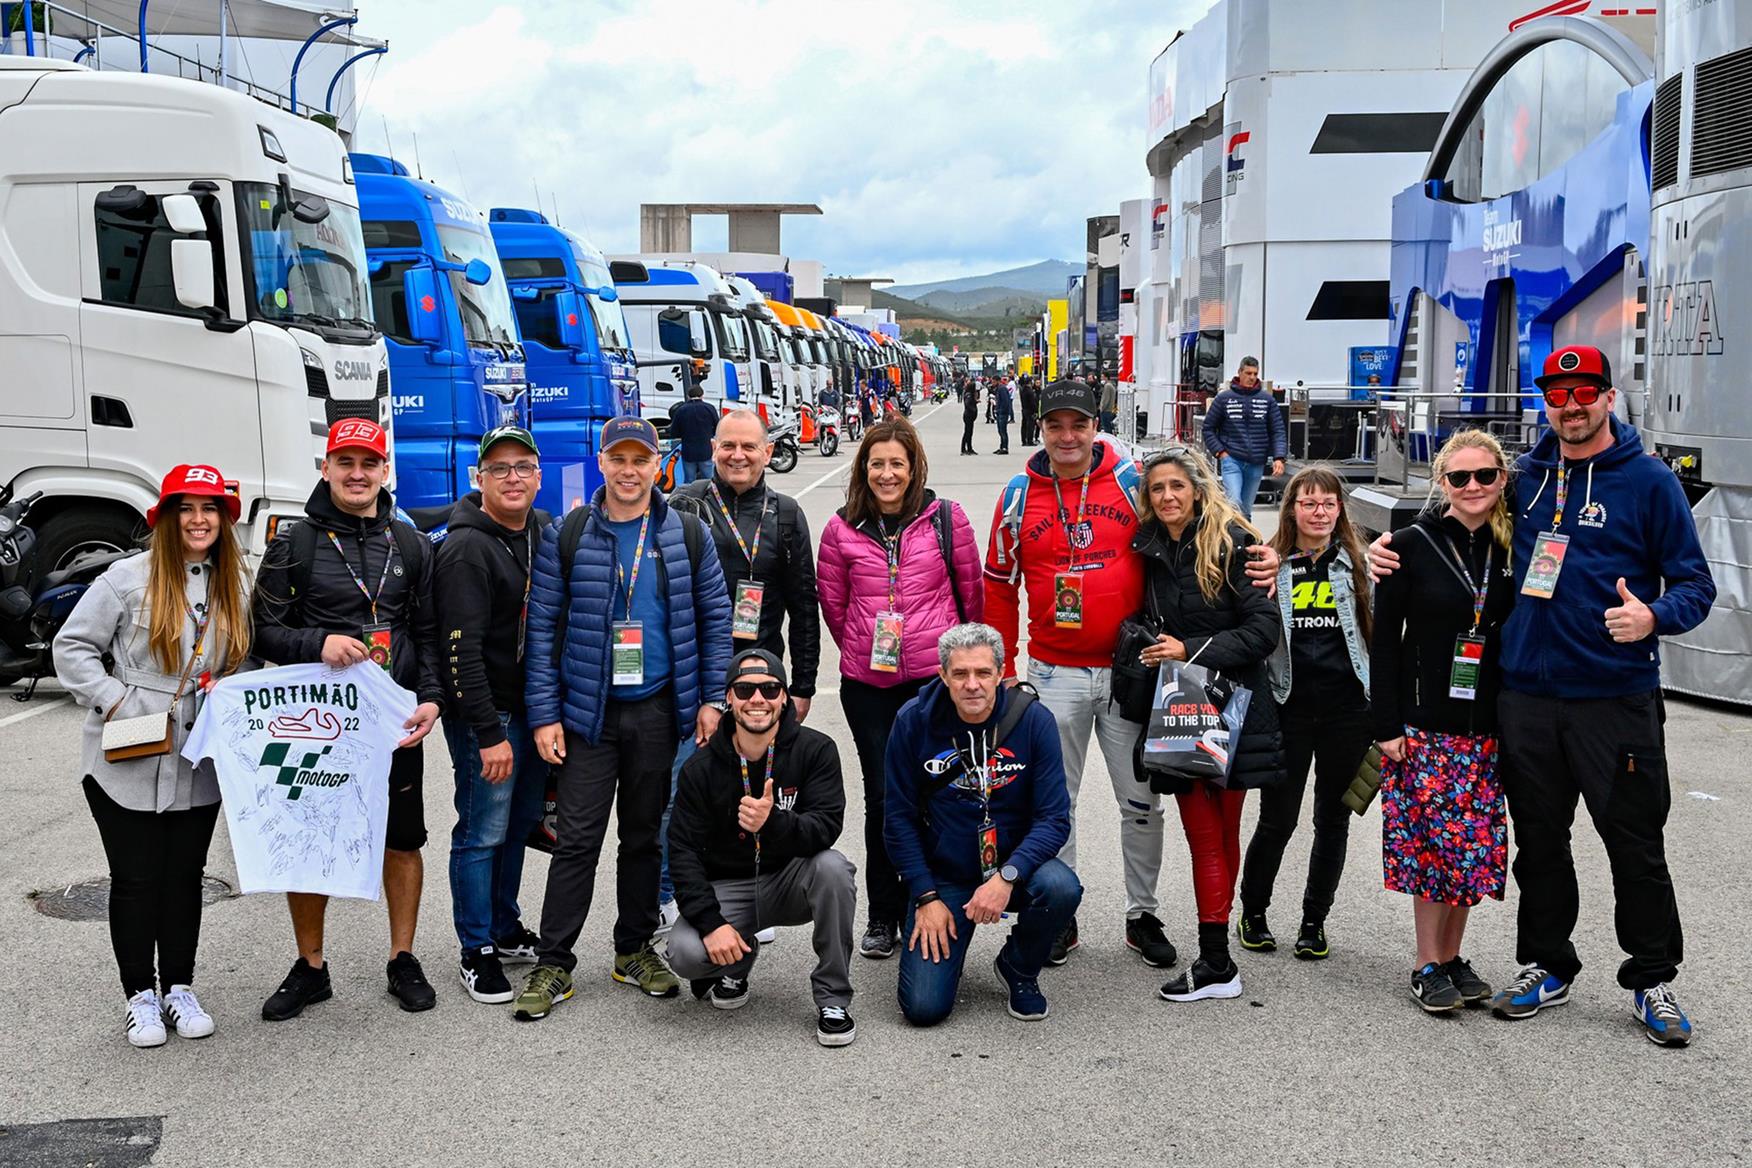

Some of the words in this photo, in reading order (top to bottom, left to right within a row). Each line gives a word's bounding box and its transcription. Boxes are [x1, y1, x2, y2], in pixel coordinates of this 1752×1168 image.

[1483, 219, 1522, 252] SUZUKI
[334, 360, 373, 380] SCANIA
[485, 367, 507, 379] SUZUKI
[1046, 389, 1063, 400] VR
[1065, 389, 1085, 398] 46
[335, 421, 380, 443] 93
[184, 467, 219, 486] 93
[1292, 581, 1337, 609] 46
[1056, 611, 1080, 619] PORTUGAL
[244, 683, 359, 715] PORTIMÃO
[248, 718, 264, 731] 20
[343, 717, 360, 731] 22
[1163, 715, 1176, 727] TO
[1201, 715, 1220, 726] TOP
